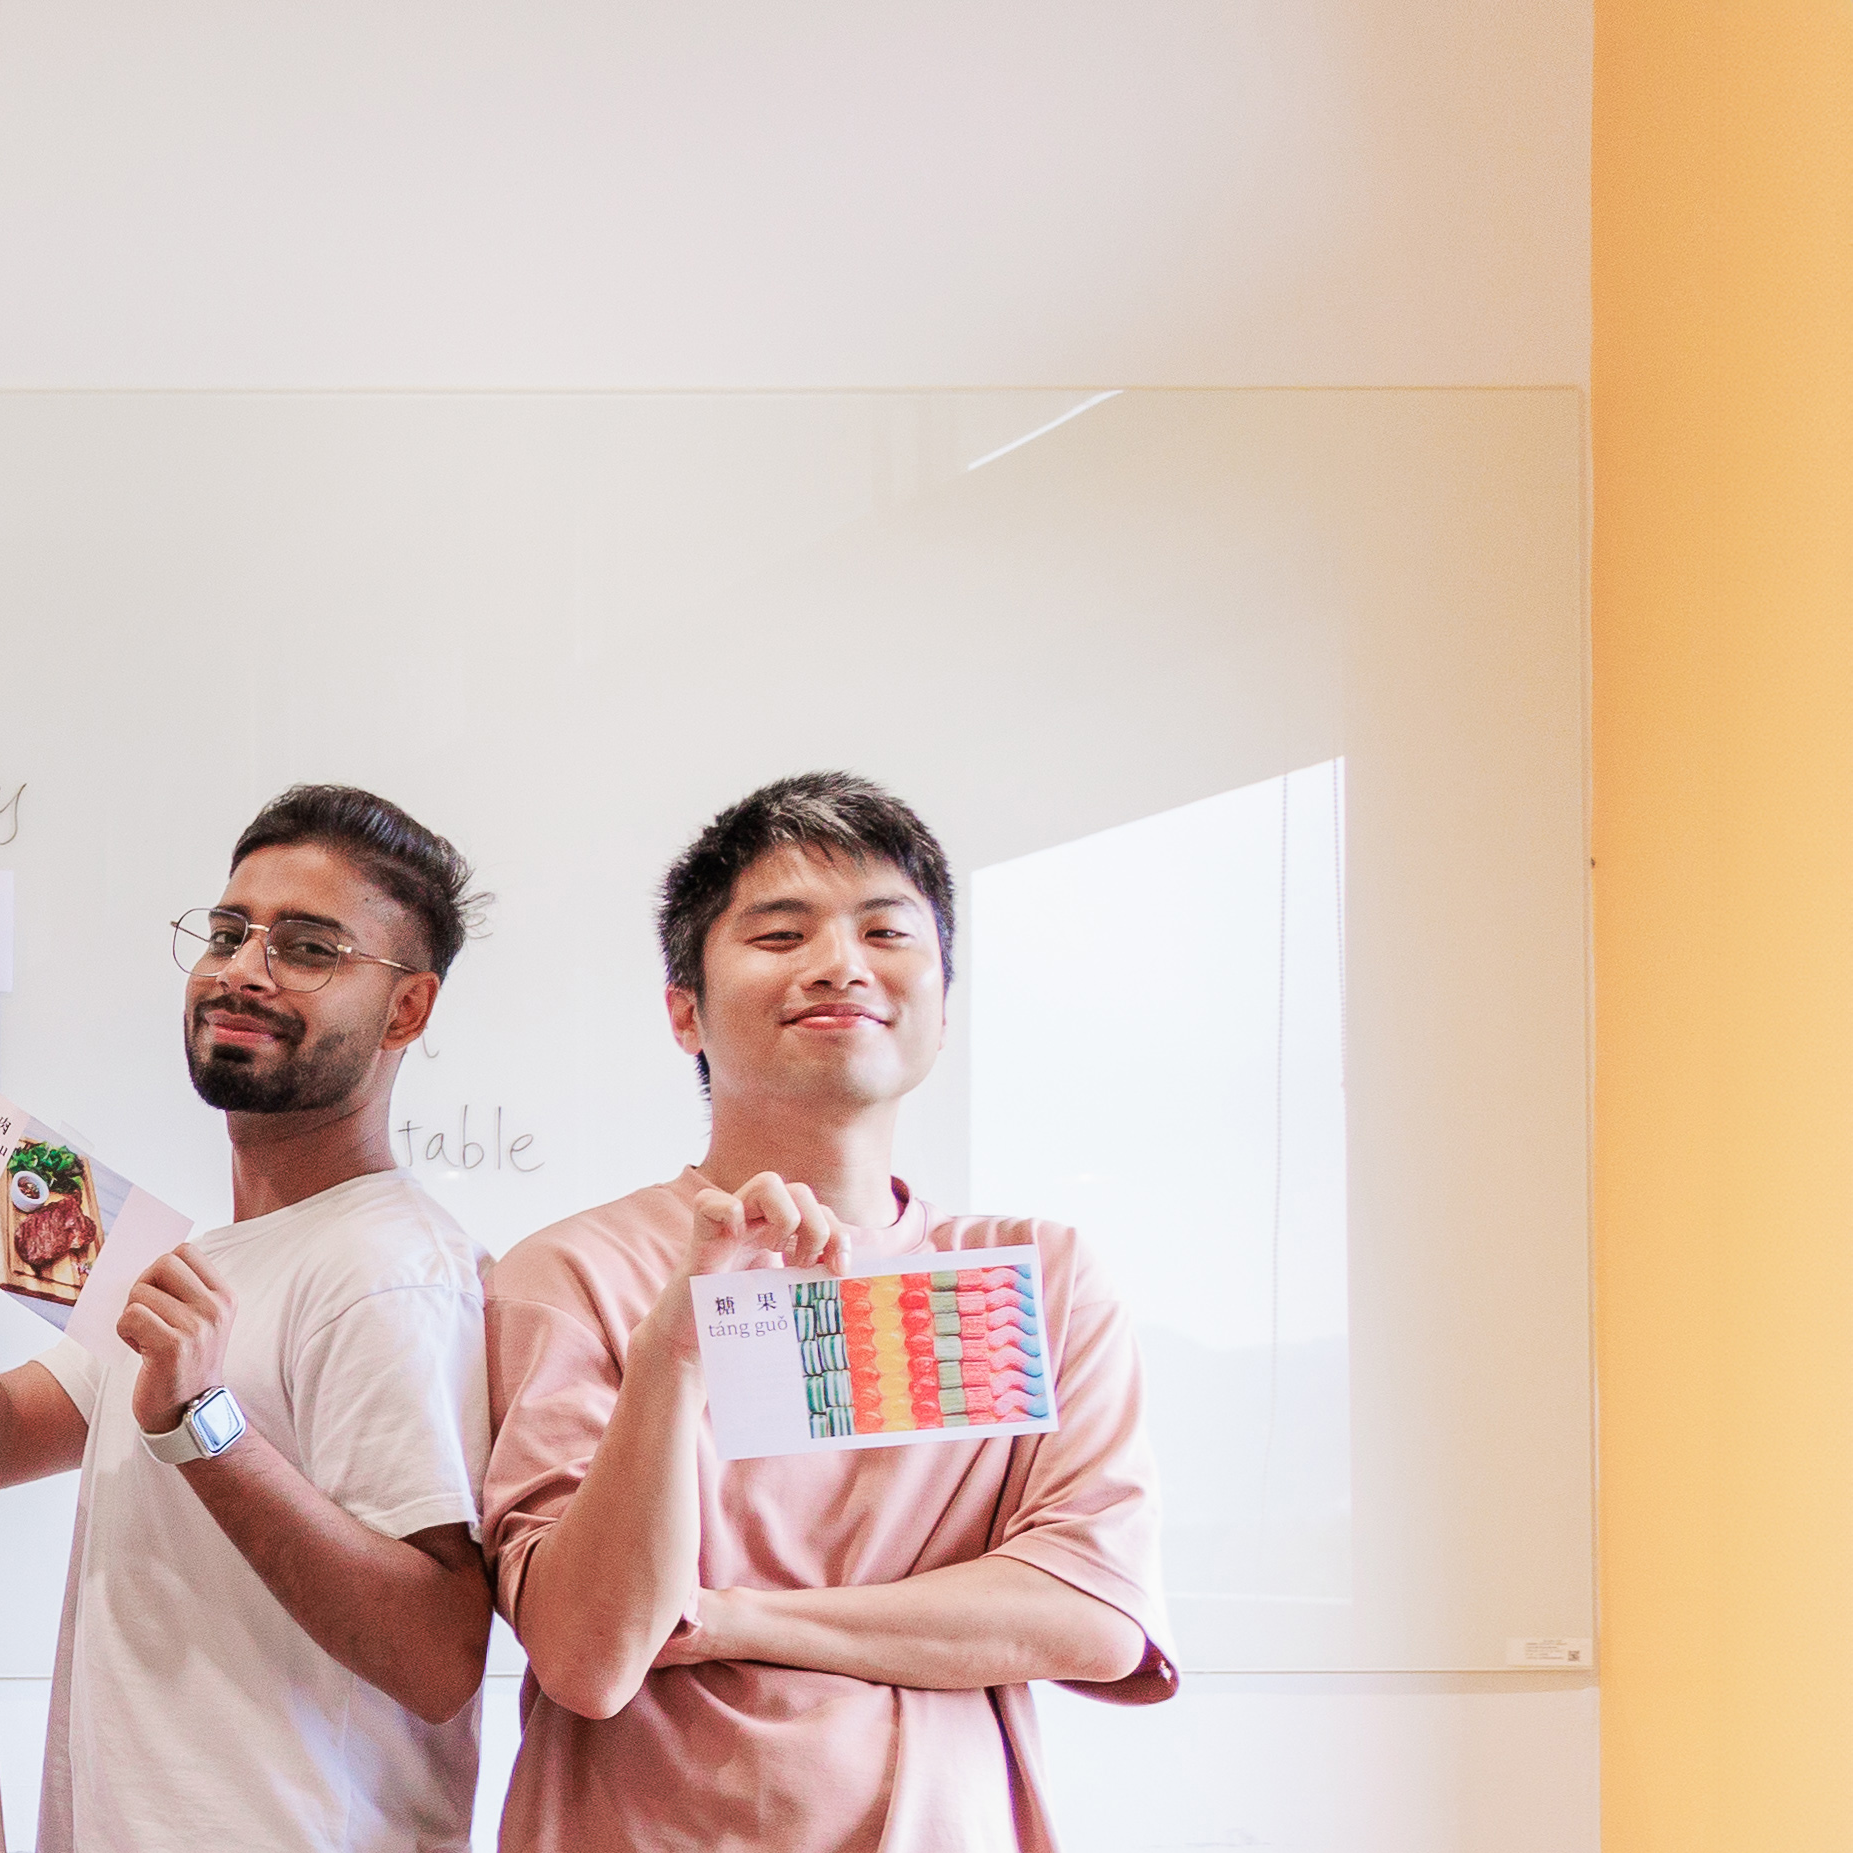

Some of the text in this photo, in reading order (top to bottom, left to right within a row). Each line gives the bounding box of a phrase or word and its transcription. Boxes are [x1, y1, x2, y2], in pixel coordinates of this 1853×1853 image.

[397, 1103, 545, 1173] table
[715, 1291, 777, 1316] 糖果
[708, 1315, 788, 1338] táng guǒ
